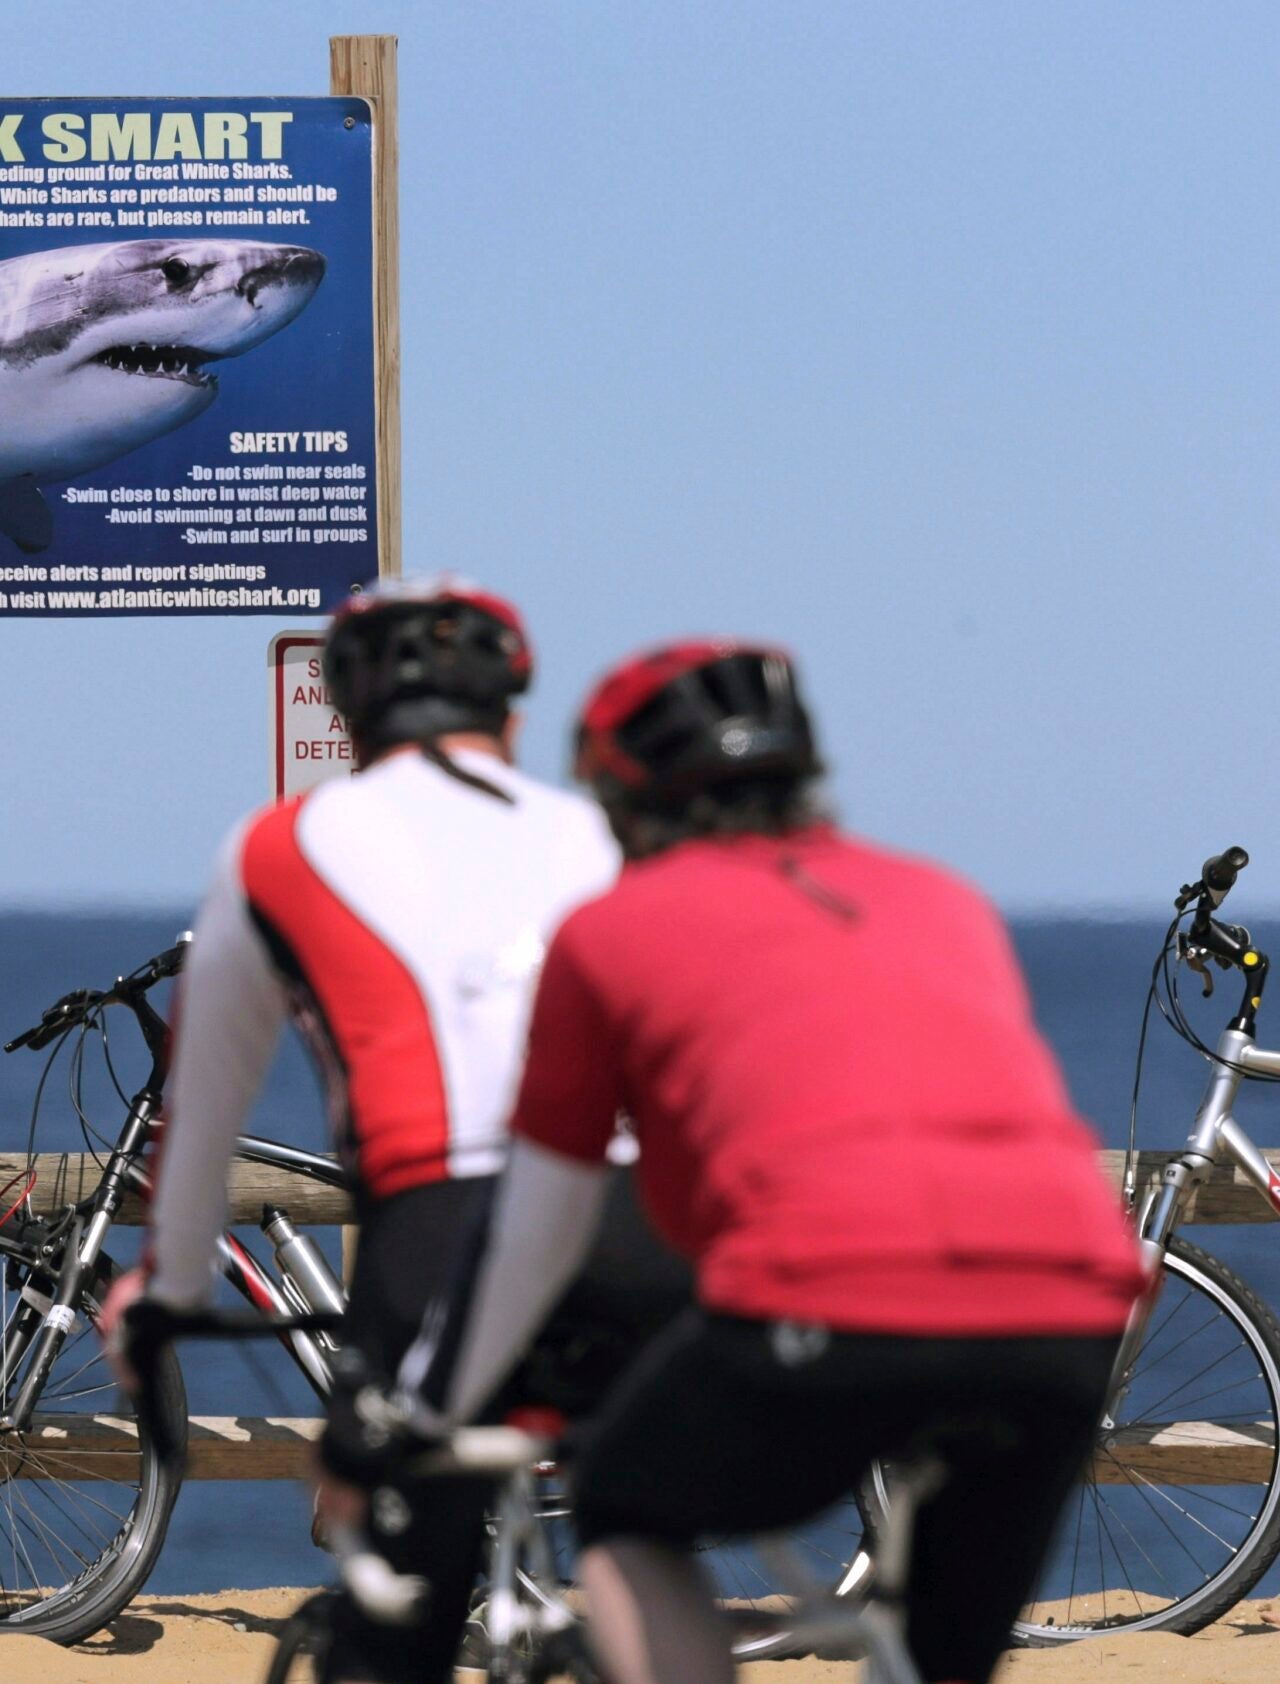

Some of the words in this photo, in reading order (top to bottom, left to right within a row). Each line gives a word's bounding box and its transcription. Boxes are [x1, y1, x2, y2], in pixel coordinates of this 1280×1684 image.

[42, 112, 293, 162] SMART
[48, 165, 105, 183] ground
[108, 165, 131, 180] for
[135, 164, 179, 180] Great
[182, 163, 229, 179] White
[233, 163, 292, 179] Sharks.
[0, 188, 48, 204] White
[51, 187, 107, 204] Sharks
[110, 189, 137, 203] are
[141, 186, 220, 204] predators
[224, 186, 254, 202] and
[257, 185, 313, 202] should
[316, 185, 337, 201] be
[47, 213, 74, 226] are
[78, 212, 114, 226] rare,
[118, 210, 145, 225] but
[148, 209, 202, 227] please
[206, 208, 263, 225] remain
[267, 208, 309, 224] alert.
[230, 432, 299, 453] SAFETY
[303, 431, 347, 452] TIPS
[188, 466, 212, 480] -Do
[216, 466, 240, 480] not
[244, 465, 283, 479] swim
[287, 467, 321, 479] near
[325, 464, 365, 478] seals
[62, 488, 108, 502] -Swim
[111, 487, 152, 502] close
[156, 488, 170, 501] to
[173, 487, 216, 501] shore
[220, 487, 234, 500] in
[238, 486, 278, 500] waist
[282, 486, 319, 501] deep
[323, 486, 366, 499] water
[106, 508, 151, 523] -Avoid
[155, 507, 233, 524] swimming
[237, 508, 251, 521] at
[255, 507, 295, 521] dawn
[299, 506, 326, 521] and
[330, 506, 366, 520] dusk
[182, 529, 227, 544] -Swim
[231, 528, 259, 543] and
[263, 528, 292, 542] surf
[296, 528, 310, 541] in
[314, 529, 367, 543] groups
[51, 565, 98, 581] alerts
[102, 565, 132, 581] and
[136, 565, 186, 582] report
[190, 564, 265, 581] sightings
[10, 592, 45, 608] visit
[48, 587, 320, 608] www.atlanticwhiteshark.org
